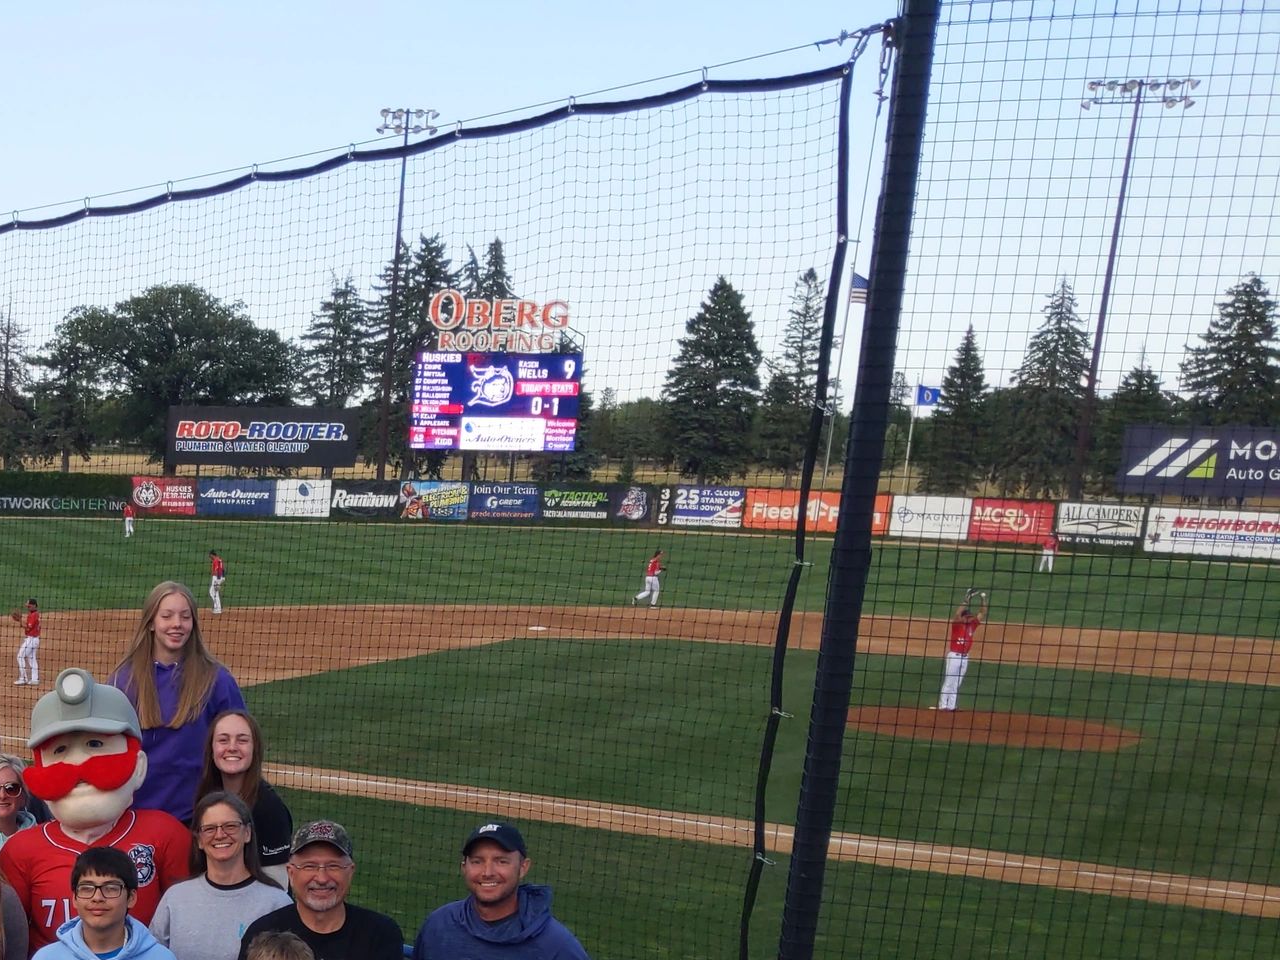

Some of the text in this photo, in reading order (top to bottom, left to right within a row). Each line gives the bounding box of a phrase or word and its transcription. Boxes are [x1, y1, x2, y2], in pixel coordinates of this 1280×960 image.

[429, 288, 569, 331] OBERG
[438, 330, 556, 353] ROOFING
[422, 353, 462, 362] HUSKIES
[519, 369, 548, 379] WELLS
[564, 360, 575, 379] 9
[176, 442, 309, 454] PLUMBING & WATER CLEANUP
[1229, 440, 1280, 460] MO
[1226, 467, 1264, 480] Auto
[200, 488, 270, 499] Auto-Owners
[473, 485, 511, 495] Join Our
[562, 491, 608, 501] TACTICAL
[675, 488, 700, 505] 25
[1063, 505, 1140, 522] ALL CAMPERS
[1076, 536, 1090, 544] Fix
[1093, 537, 1135, 546] Campers
[1172, 531, 1206, 539] PLUMBING
[1245, 535, 1275, 543] COOLING
[479, 823, 500, 834] CAT
[41, 898, 71, 928] 71
